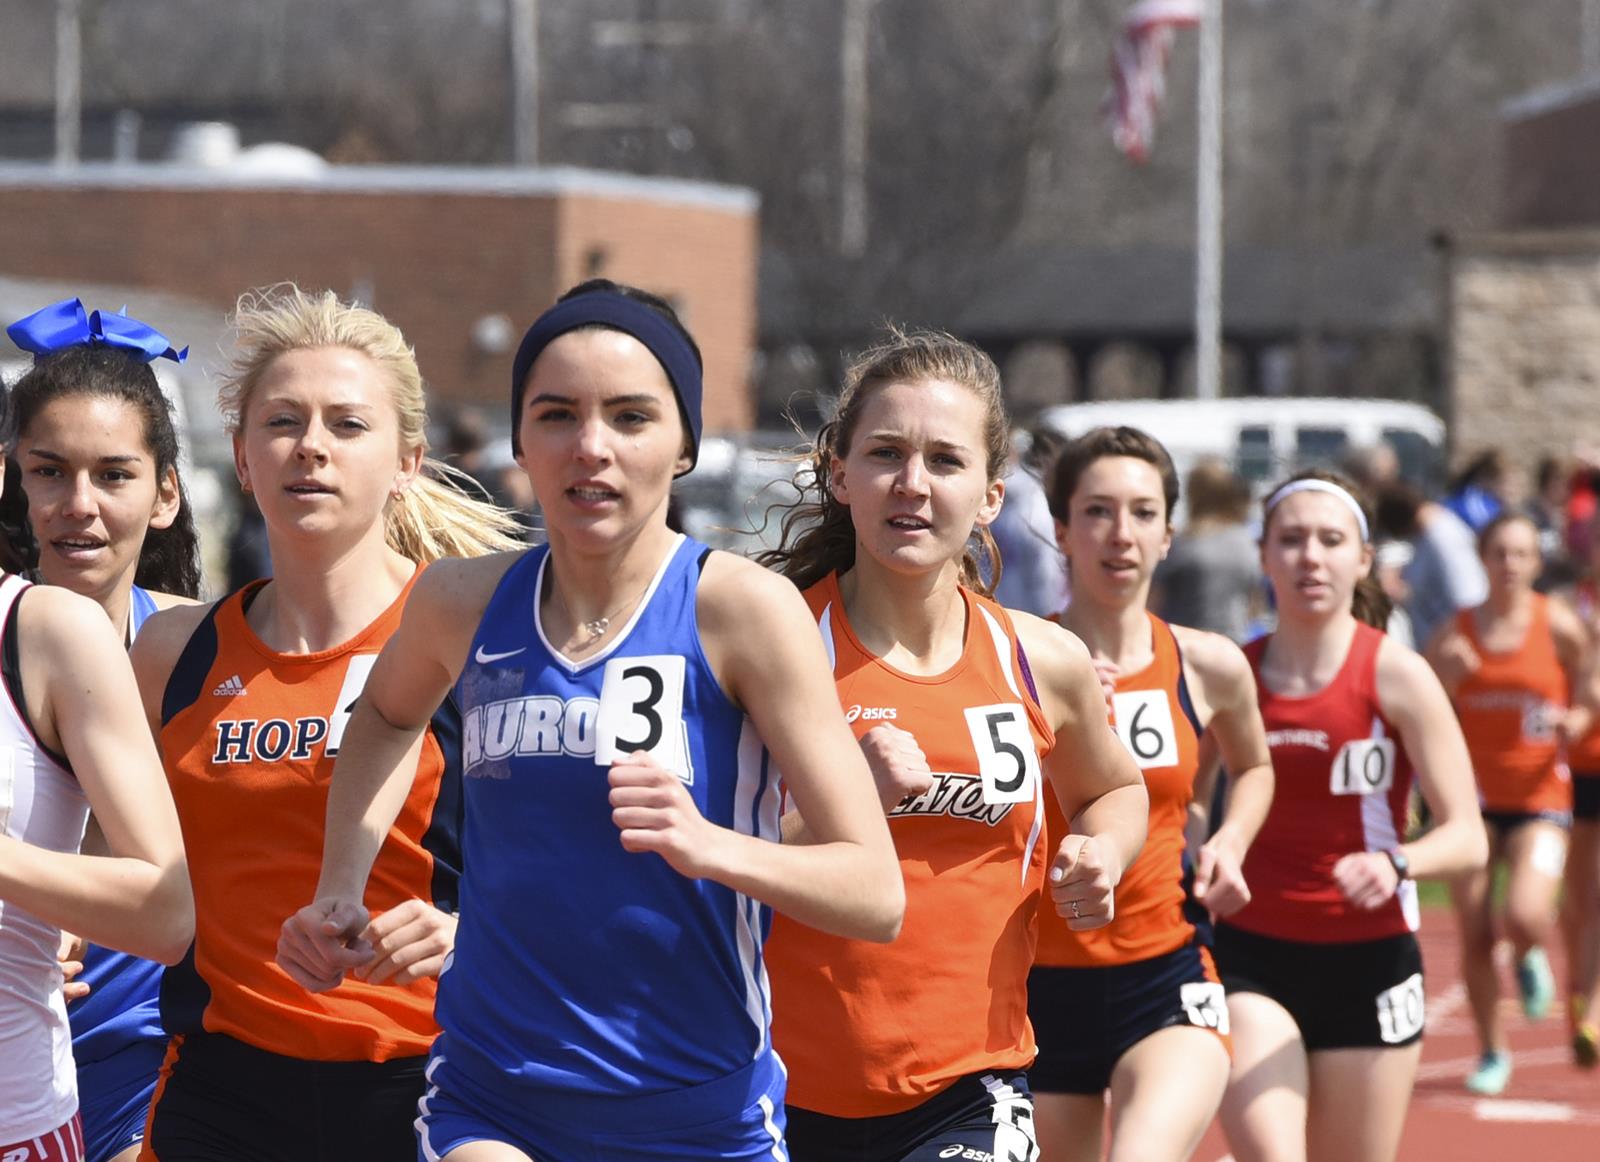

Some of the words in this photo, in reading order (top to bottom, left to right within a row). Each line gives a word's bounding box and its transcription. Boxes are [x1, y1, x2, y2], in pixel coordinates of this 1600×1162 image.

[213, 687, 247, 696] adidas
[615, 665, 664, 753] 3
[862, 707, 897, 720] asics
[212, 716, 341, 764] HOP
[985, 711, 1026, 793] 5
[1130, 702, 1164, 759] 6
[1342, 744, 1386, 787] 10
